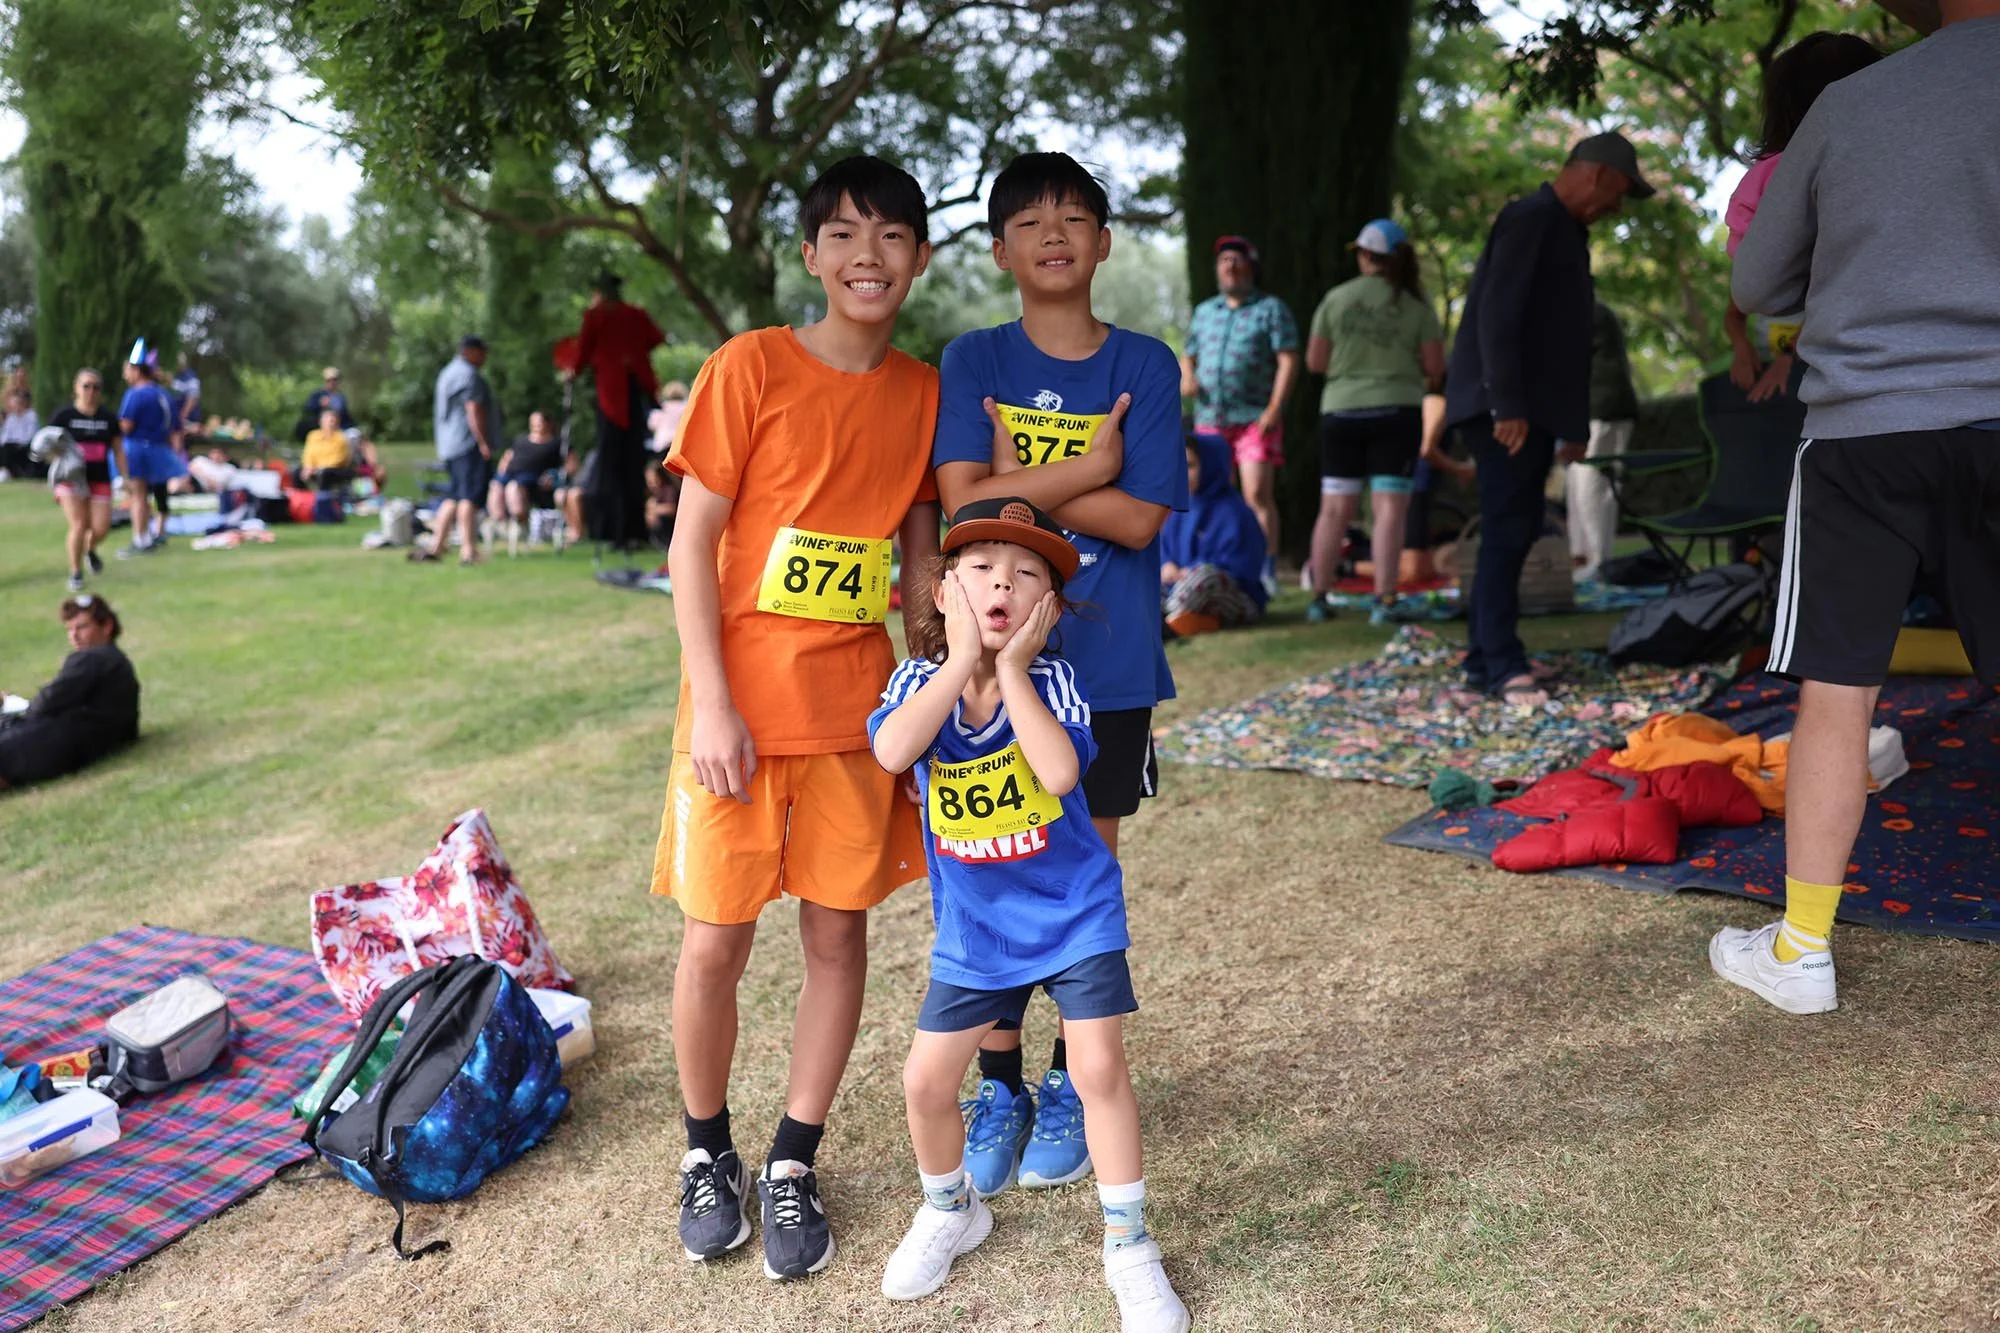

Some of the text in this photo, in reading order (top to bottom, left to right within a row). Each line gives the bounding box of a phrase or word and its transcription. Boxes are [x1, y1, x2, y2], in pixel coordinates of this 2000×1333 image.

[1016, 412, 1087, 431] VINE RUN
[1010, 505, 1029, 513] LITTLE
[795, 535, 866, 554] VINE RUN
[783, 555, 863, 600] 874
[935, 751, 1015, 779] VINE RUN
[937, 773, 1025, 821] 864
